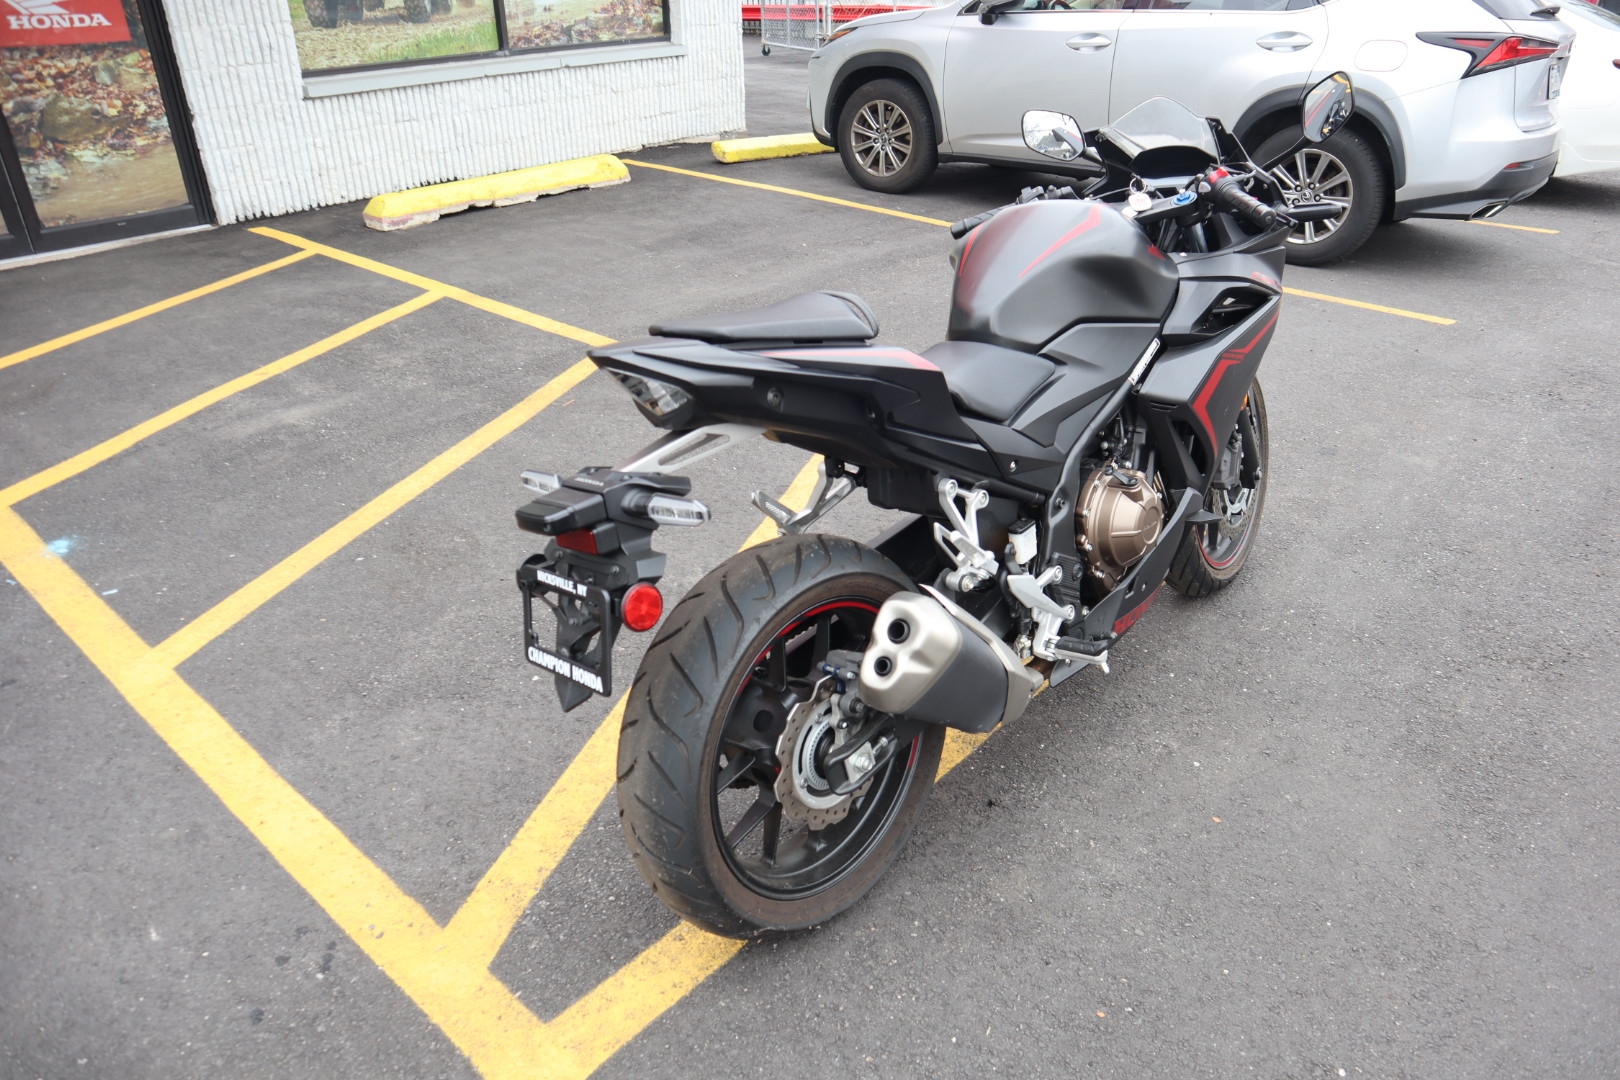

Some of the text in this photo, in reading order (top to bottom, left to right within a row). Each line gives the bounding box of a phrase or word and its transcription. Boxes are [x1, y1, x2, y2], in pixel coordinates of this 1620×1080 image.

[6, 13, 112, 30] HONDA
[527, 646, 604, 693] CHAMPION HONDA
